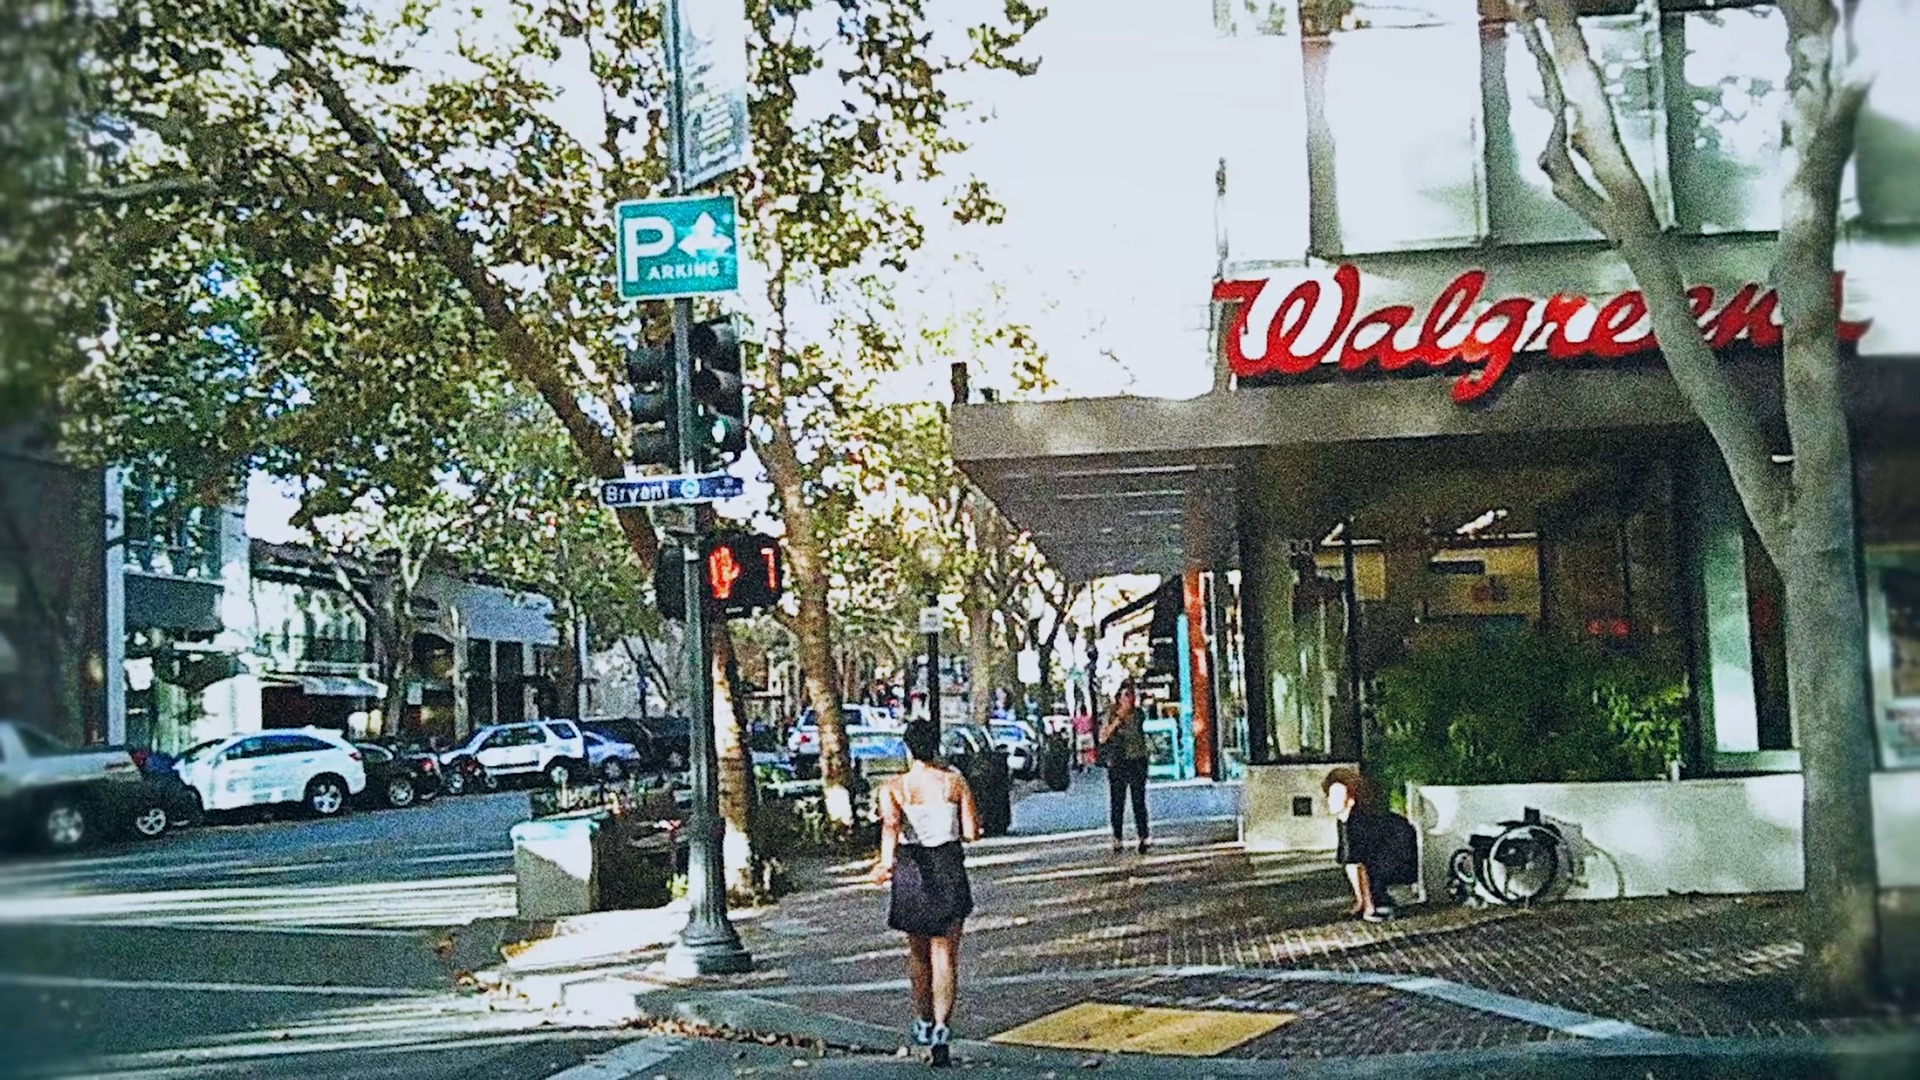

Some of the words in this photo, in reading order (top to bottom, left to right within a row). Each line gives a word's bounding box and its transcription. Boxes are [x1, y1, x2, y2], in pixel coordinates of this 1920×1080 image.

[622, 215, 720, 283] PARKING
[1212, 263, 1873, 402] Walgren
[605, 481, 669, 503] Bryant
